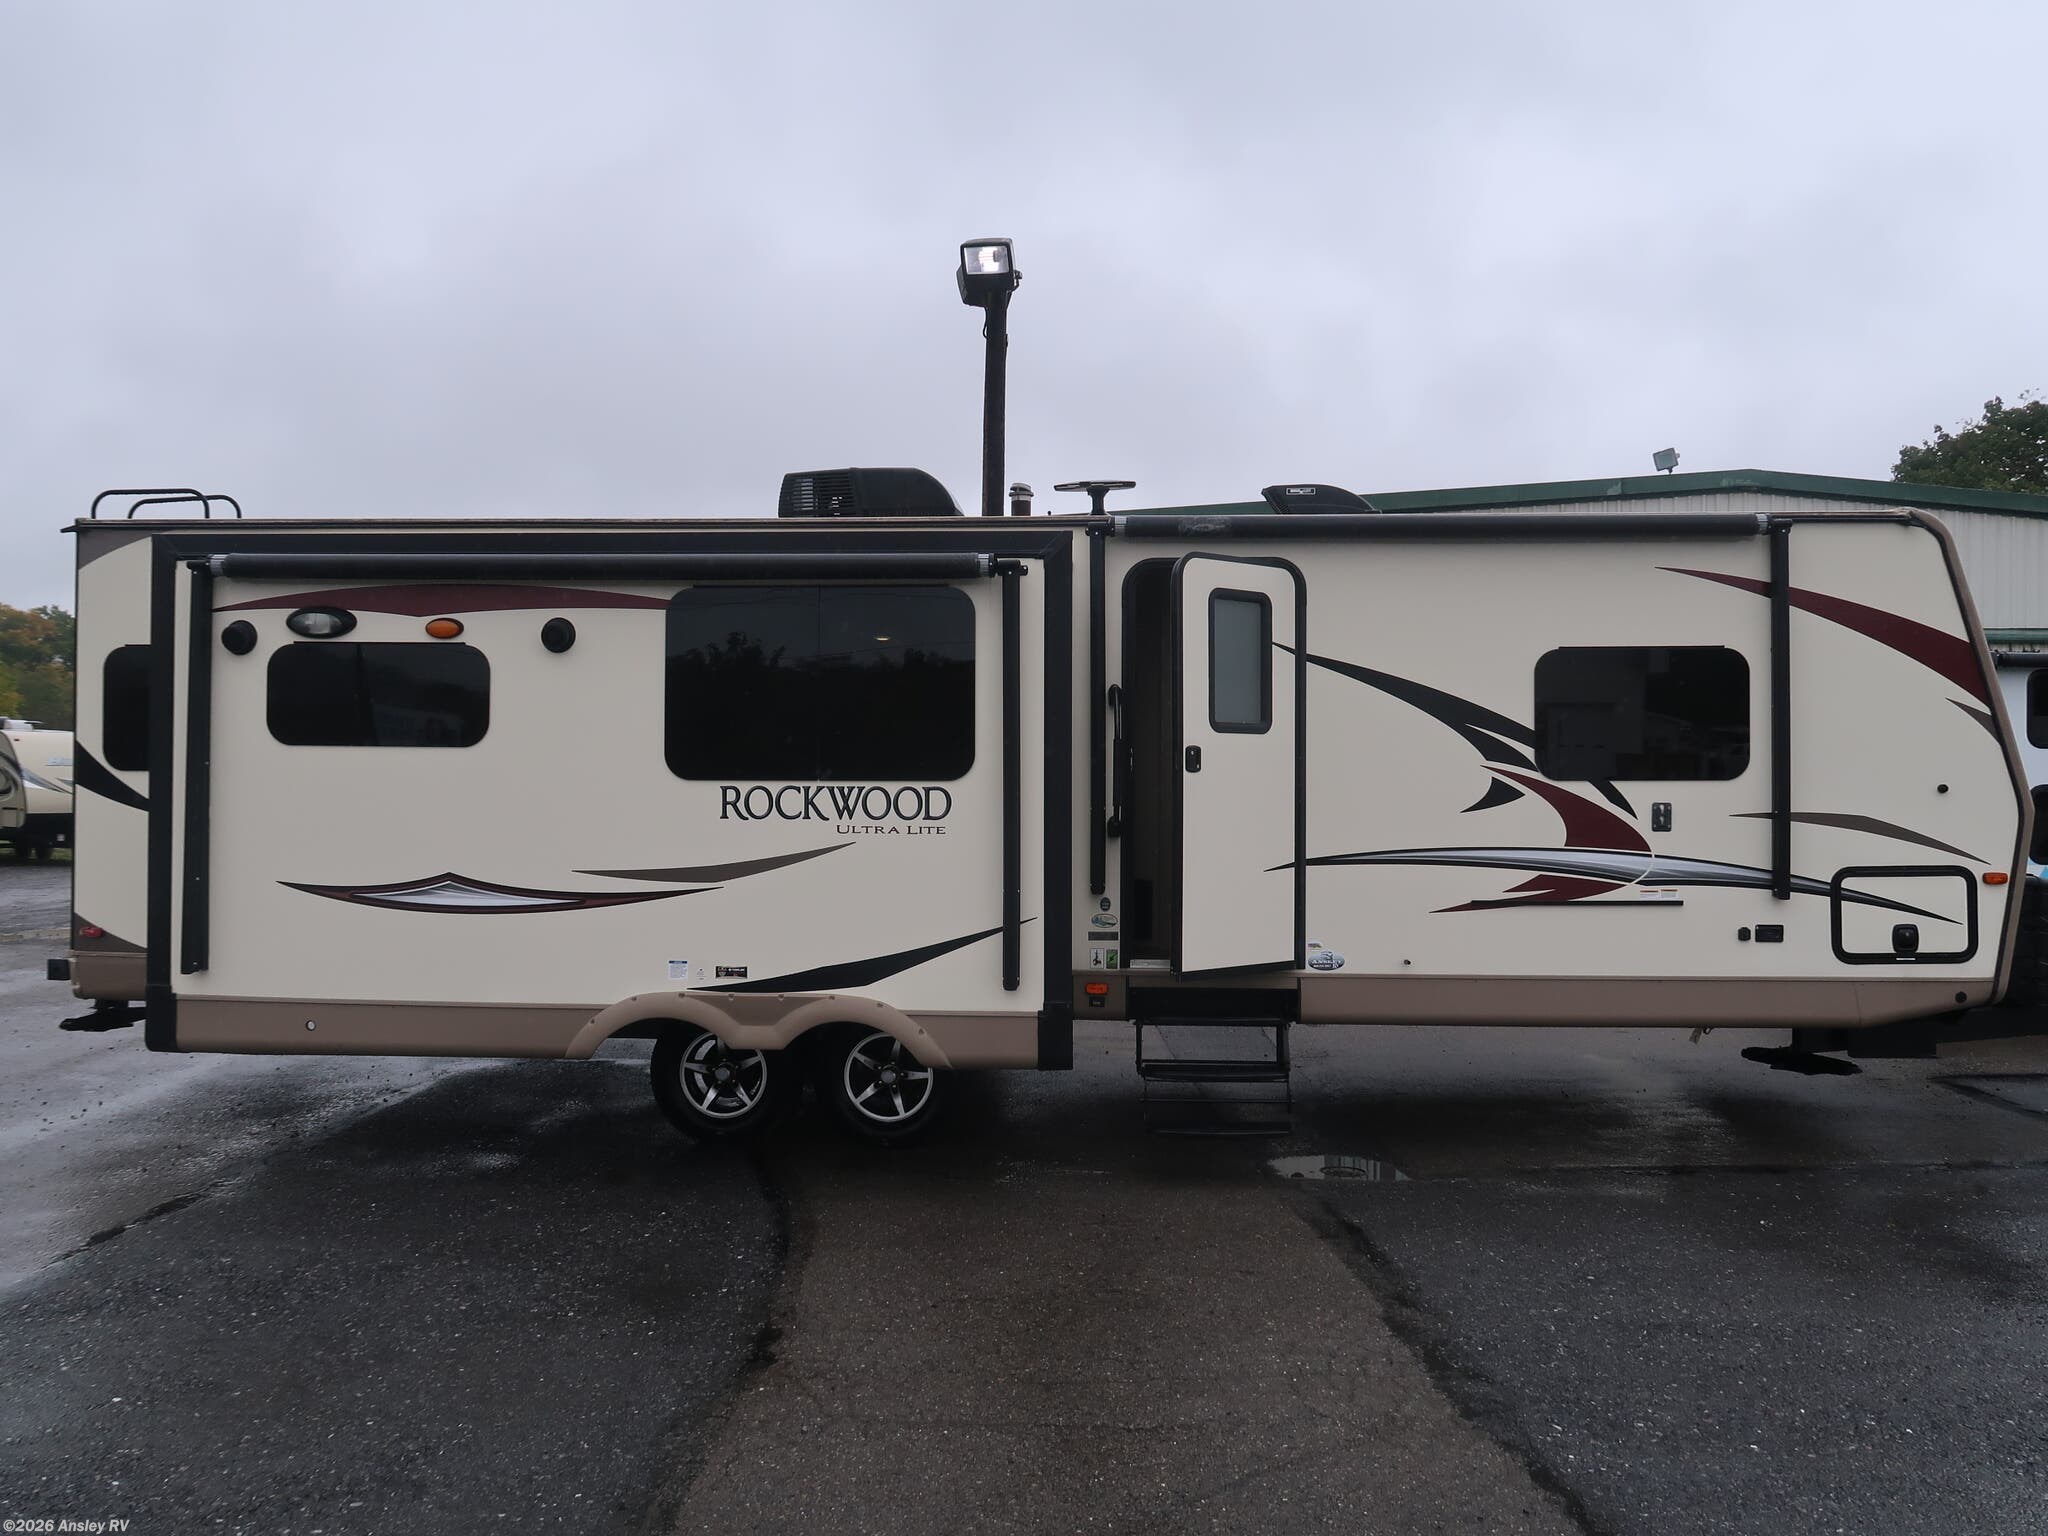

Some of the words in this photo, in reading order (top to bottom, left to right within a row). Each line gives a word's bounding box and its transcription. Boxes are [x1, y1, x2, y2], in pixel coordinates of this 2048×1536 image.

[719, 785, 952, 821] ROCKWOOD
[836, 824, 900, 835] ULTRA
[906, 825, 946, 835] LITE
